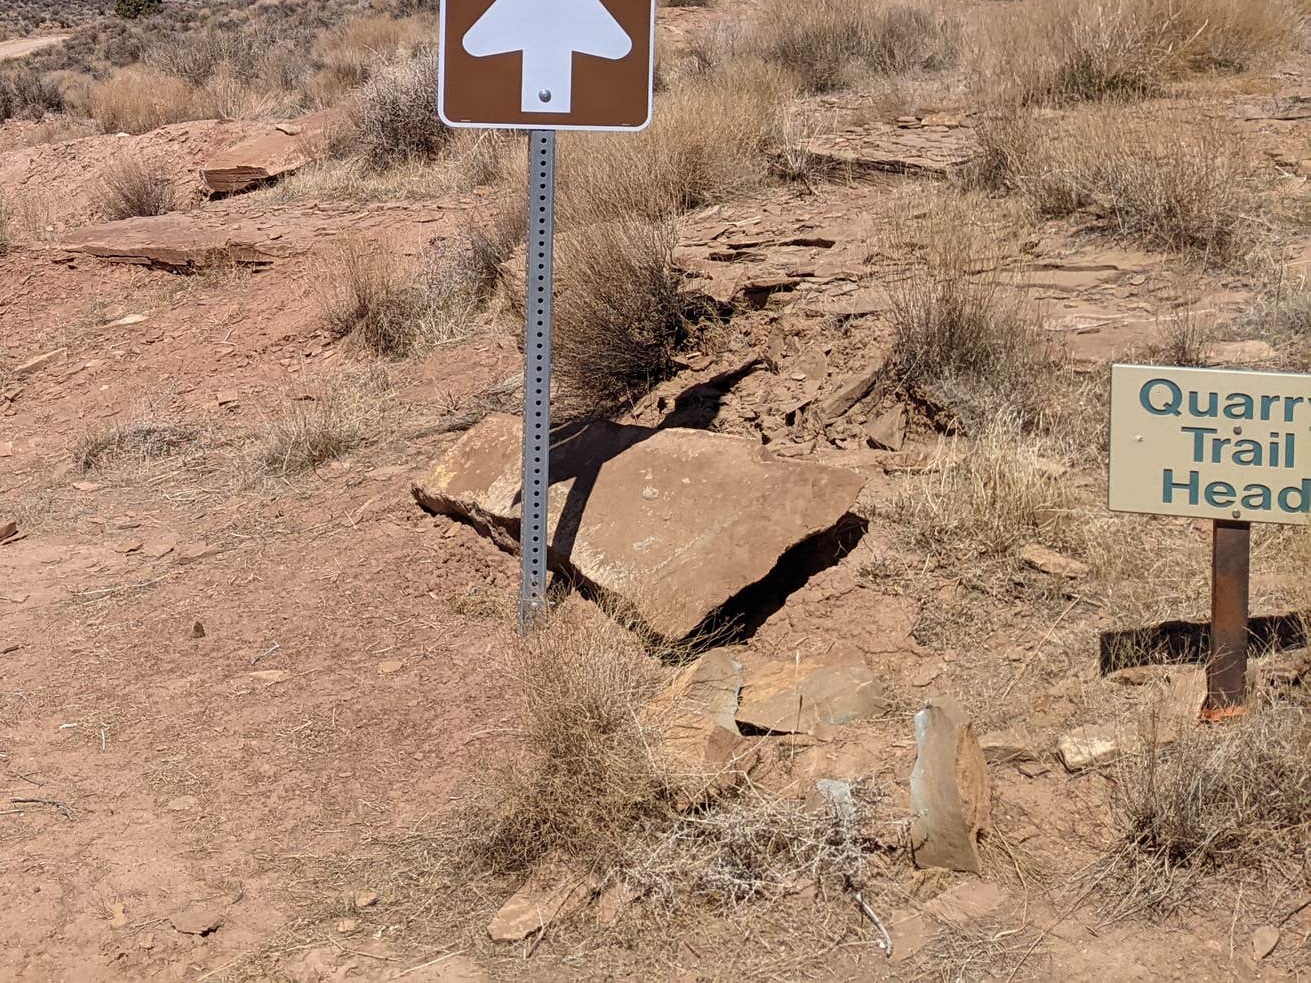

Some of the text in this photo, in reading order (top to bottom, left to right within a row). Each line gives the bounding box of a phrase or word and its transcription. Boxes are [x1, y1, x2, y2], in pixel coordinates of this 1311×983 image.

[1139, 377, 1311, 422] Quarr
[1180, 426, 1295, 468] Trail
[1162, 468, 1311, 513] Head
